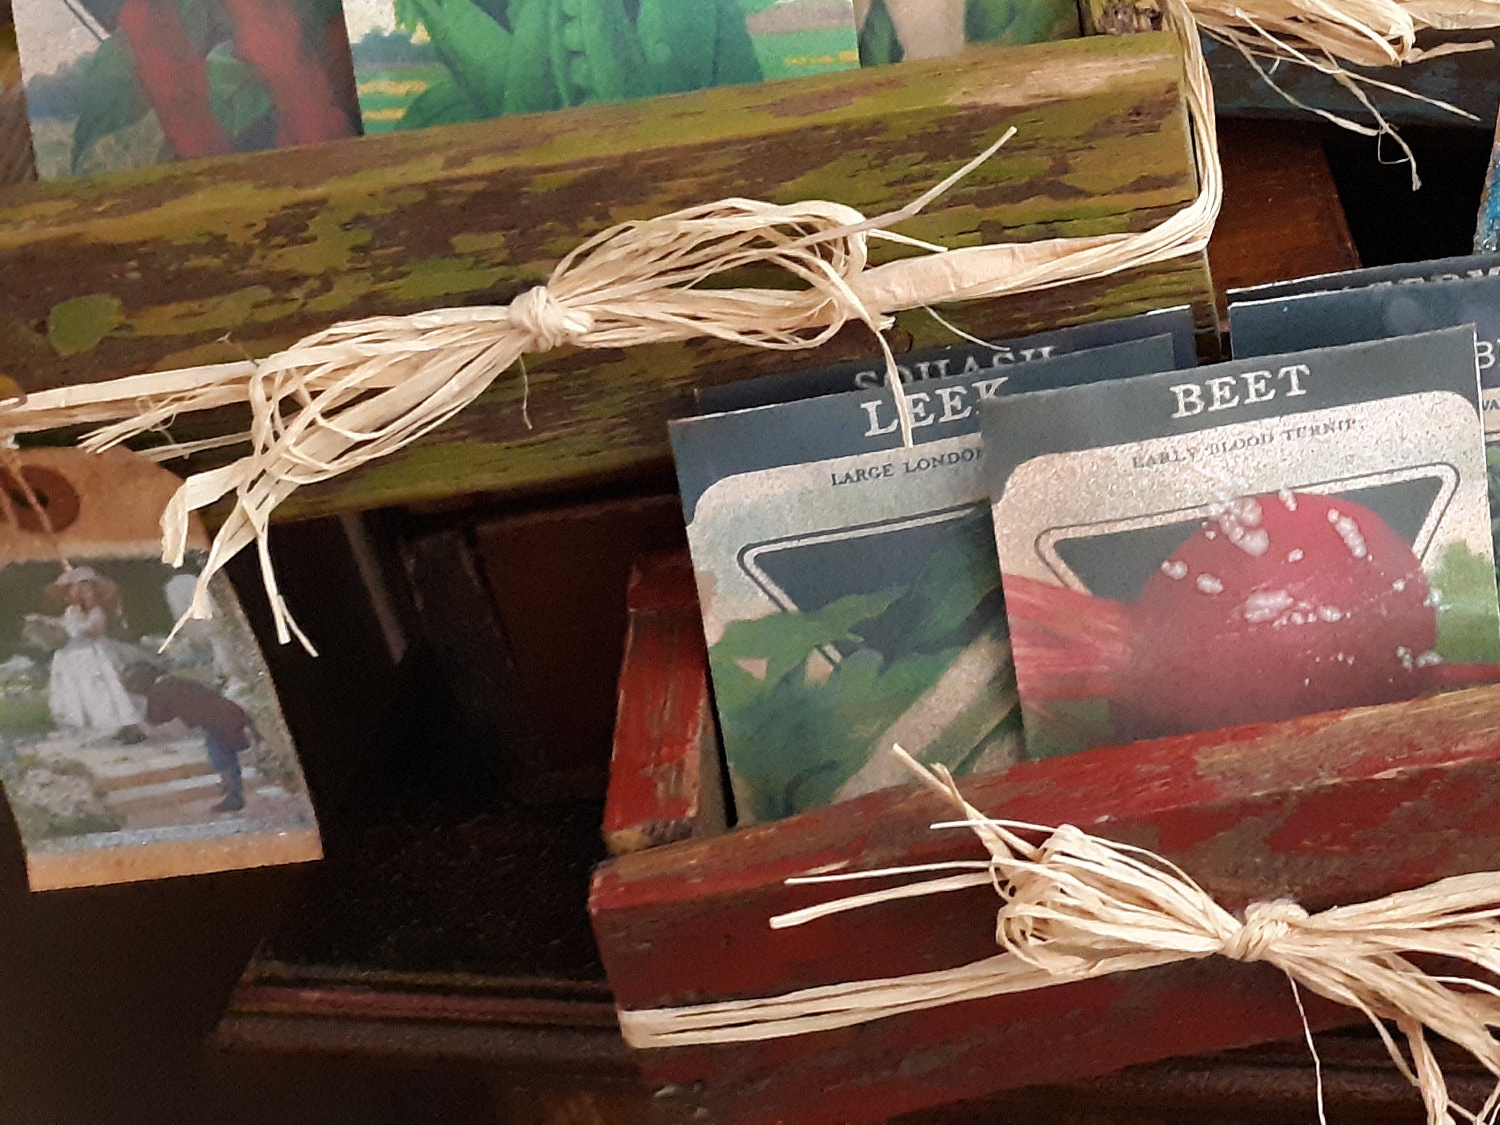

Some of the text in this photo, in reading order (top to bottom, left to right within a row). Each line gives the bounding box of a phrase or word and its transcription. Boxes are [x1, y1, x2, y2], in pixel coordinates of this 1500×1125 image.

[1169, 364, 1310, 419] BEET
[831, 448, 984, 486] LARGE LONDO
